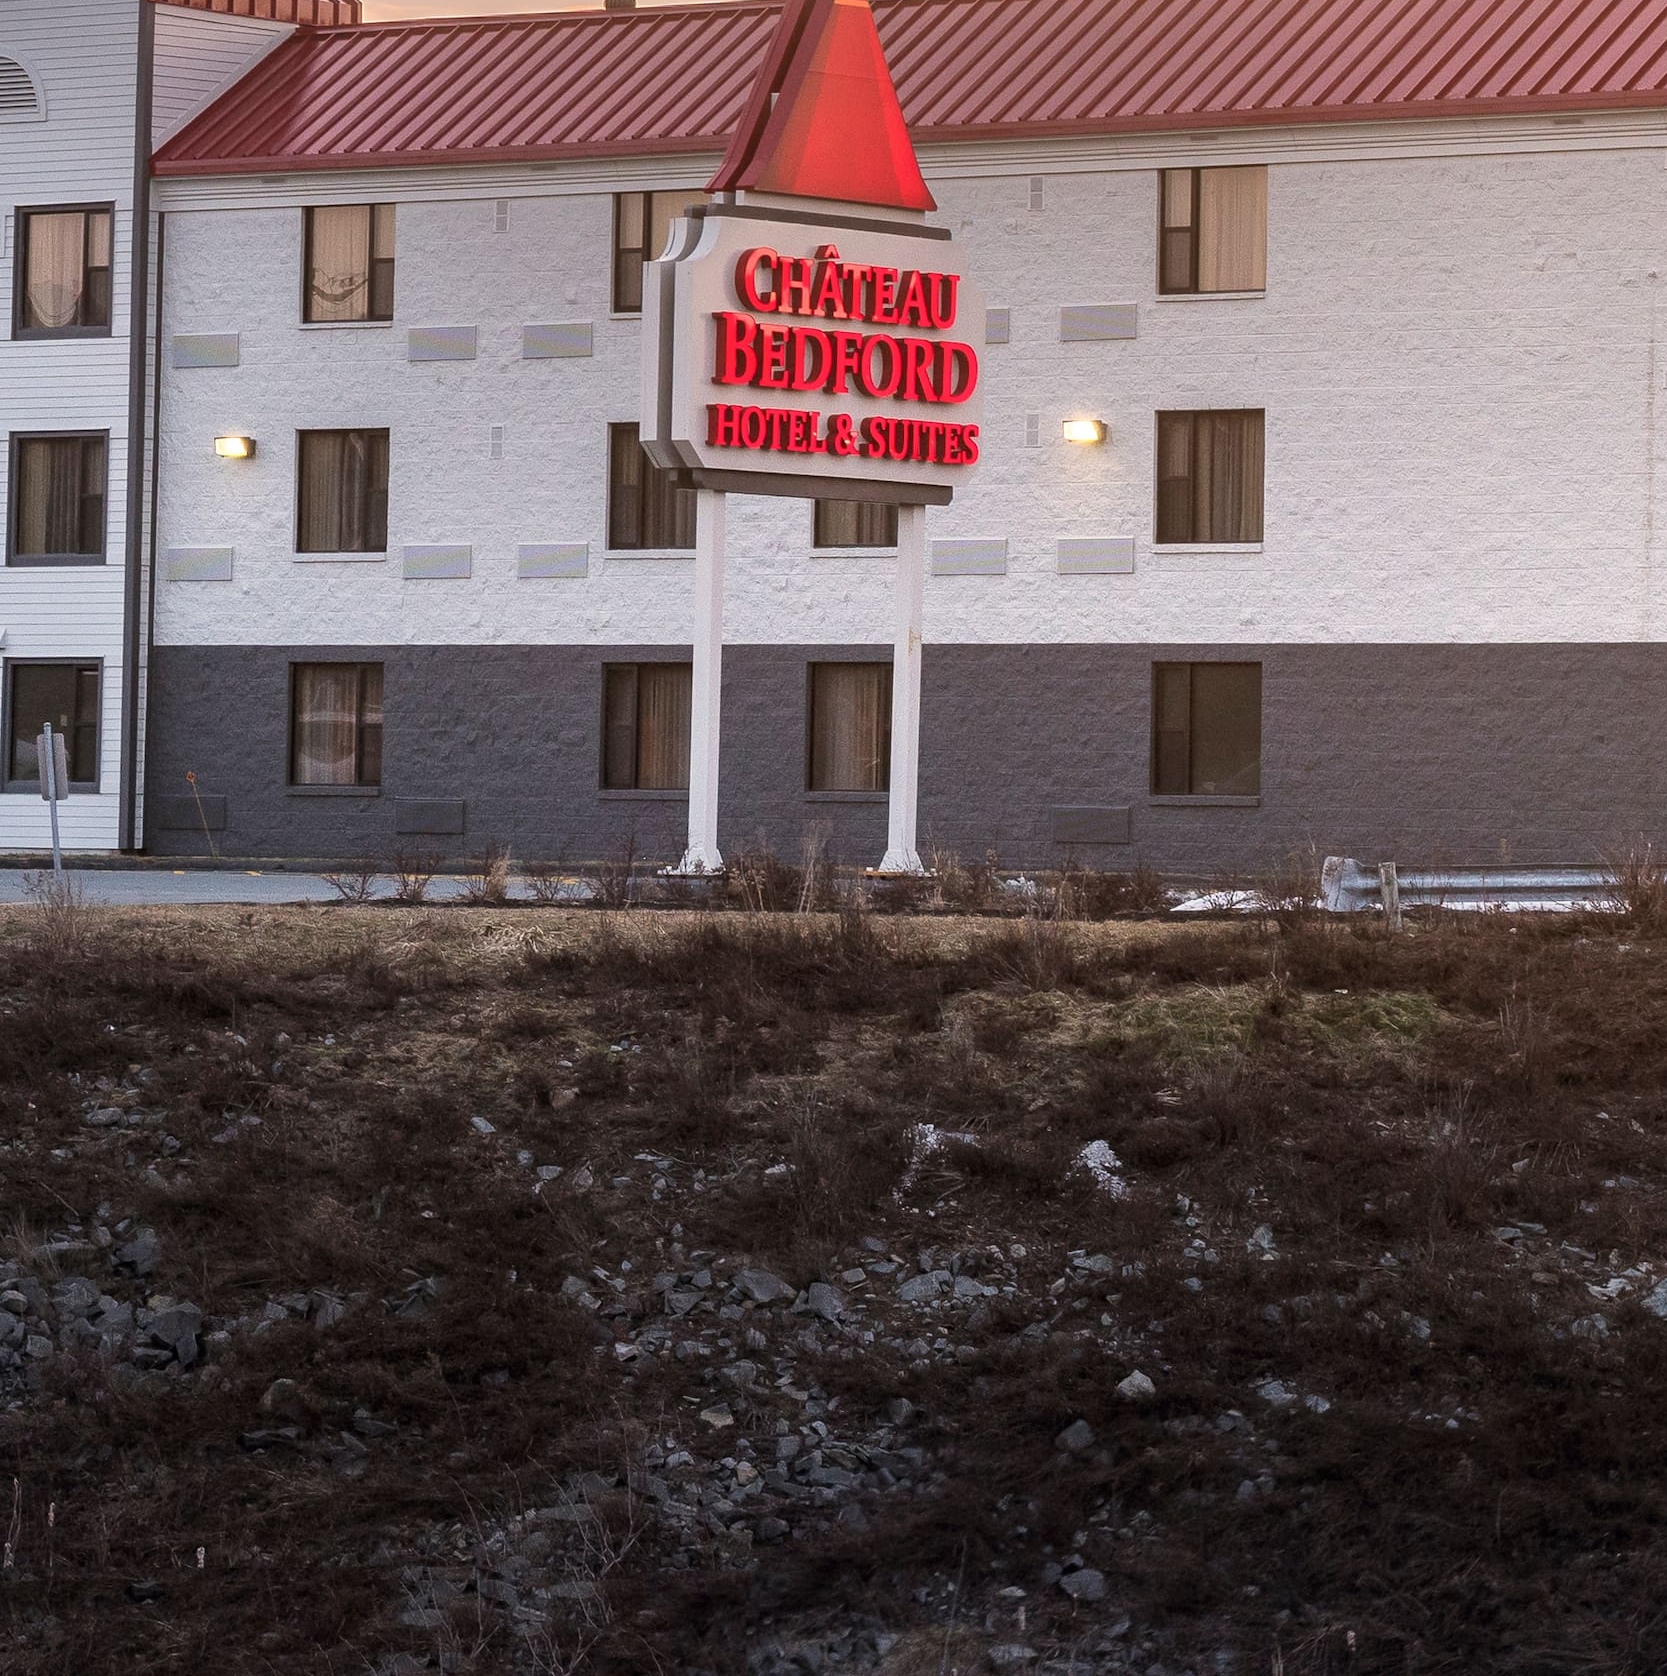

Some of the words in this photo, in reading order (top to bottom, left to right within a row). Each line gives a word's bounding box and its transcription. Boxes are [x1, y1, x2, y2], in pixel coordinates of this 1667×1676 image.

[734, 244, 960, 330] CHÂTEAU
[712, 312, 979, 404] BEDFORD
[706, 404, 827, 453] HOTEL
[827, 413, 861, 457] &
[861, 416, 980, 466] SUITES
